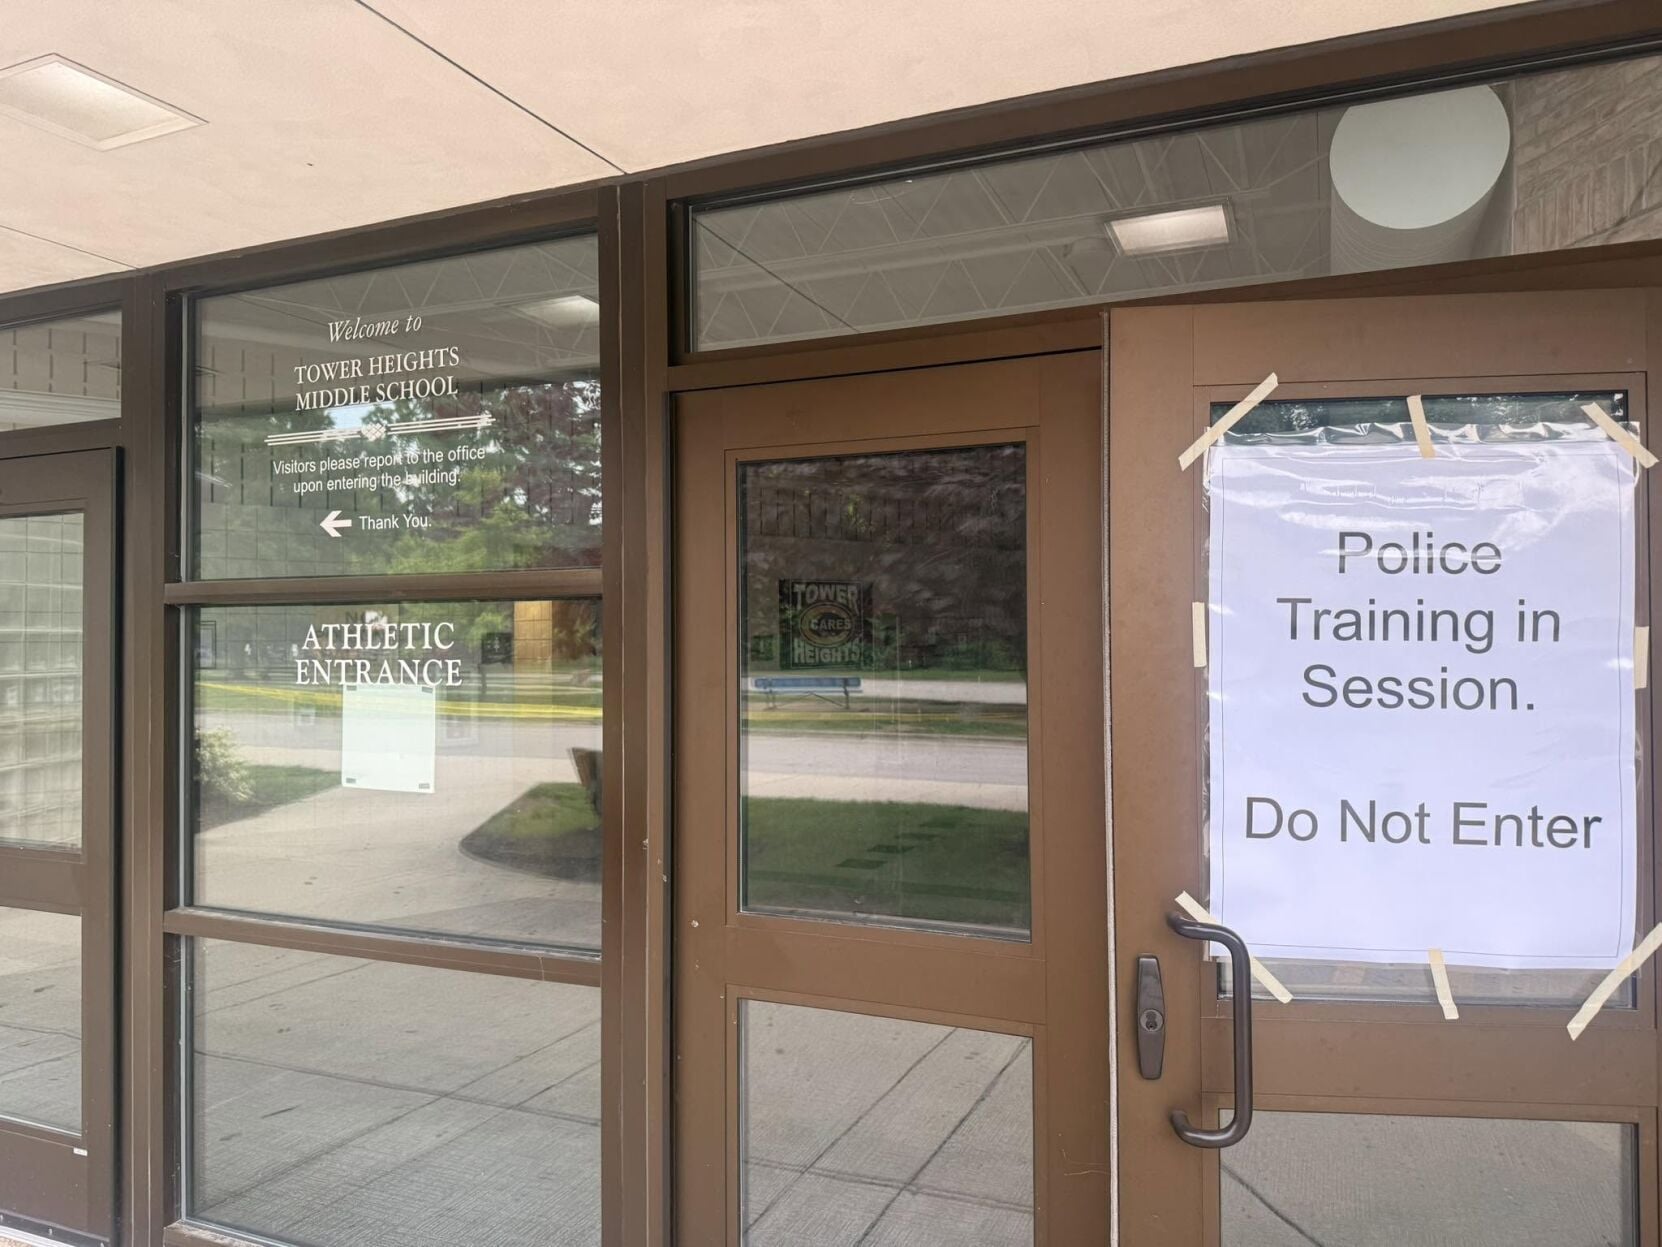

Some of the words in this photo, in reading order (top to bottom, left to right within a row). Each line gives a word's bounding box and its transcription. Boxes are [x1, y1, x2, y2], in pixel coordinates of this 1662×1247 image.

[328, 317, 399, 343] Welcome
[405, 314, 422, 331] to
[294, 358, 363, 385] TOWER
[368, 346, 460, 376] HEIGHTS
[295, 384, 371, 411] MIDDLE
[375, 375, 459, 403] SCHOOL
[273, 459, 316, 475] Visitors
[320, 456, 360, 475] please
[364, 451, 403, 471] report
[406, 450, 419, 465] to
[423, 448, 444, 464] the
[447, 445, 486, 461] office
[293, 480, 323, 496] upon
[326, 474, 378, 492] entering
[381, 471, 401, 488] the
[358, 514, 400, 530] Thank
[1337, 531, 1503, 575] Police
[792, 582, 861, 616] TOWER
[301, 621, 455, 651] ATHLETIC
[1276, 597, 1494, 655] Training
[1517, 598, 1561, 643] in
[792, 637, 861, 664] HEIGHTS
[295, 658, 463, 687] ENTRANCE
[1301, 664, 1536, 711] Session.
[1245, 796, 1319, 842] Do
[1339, 799, 1431, 845] Not
[1452, 801, 1603, 849] Enter
